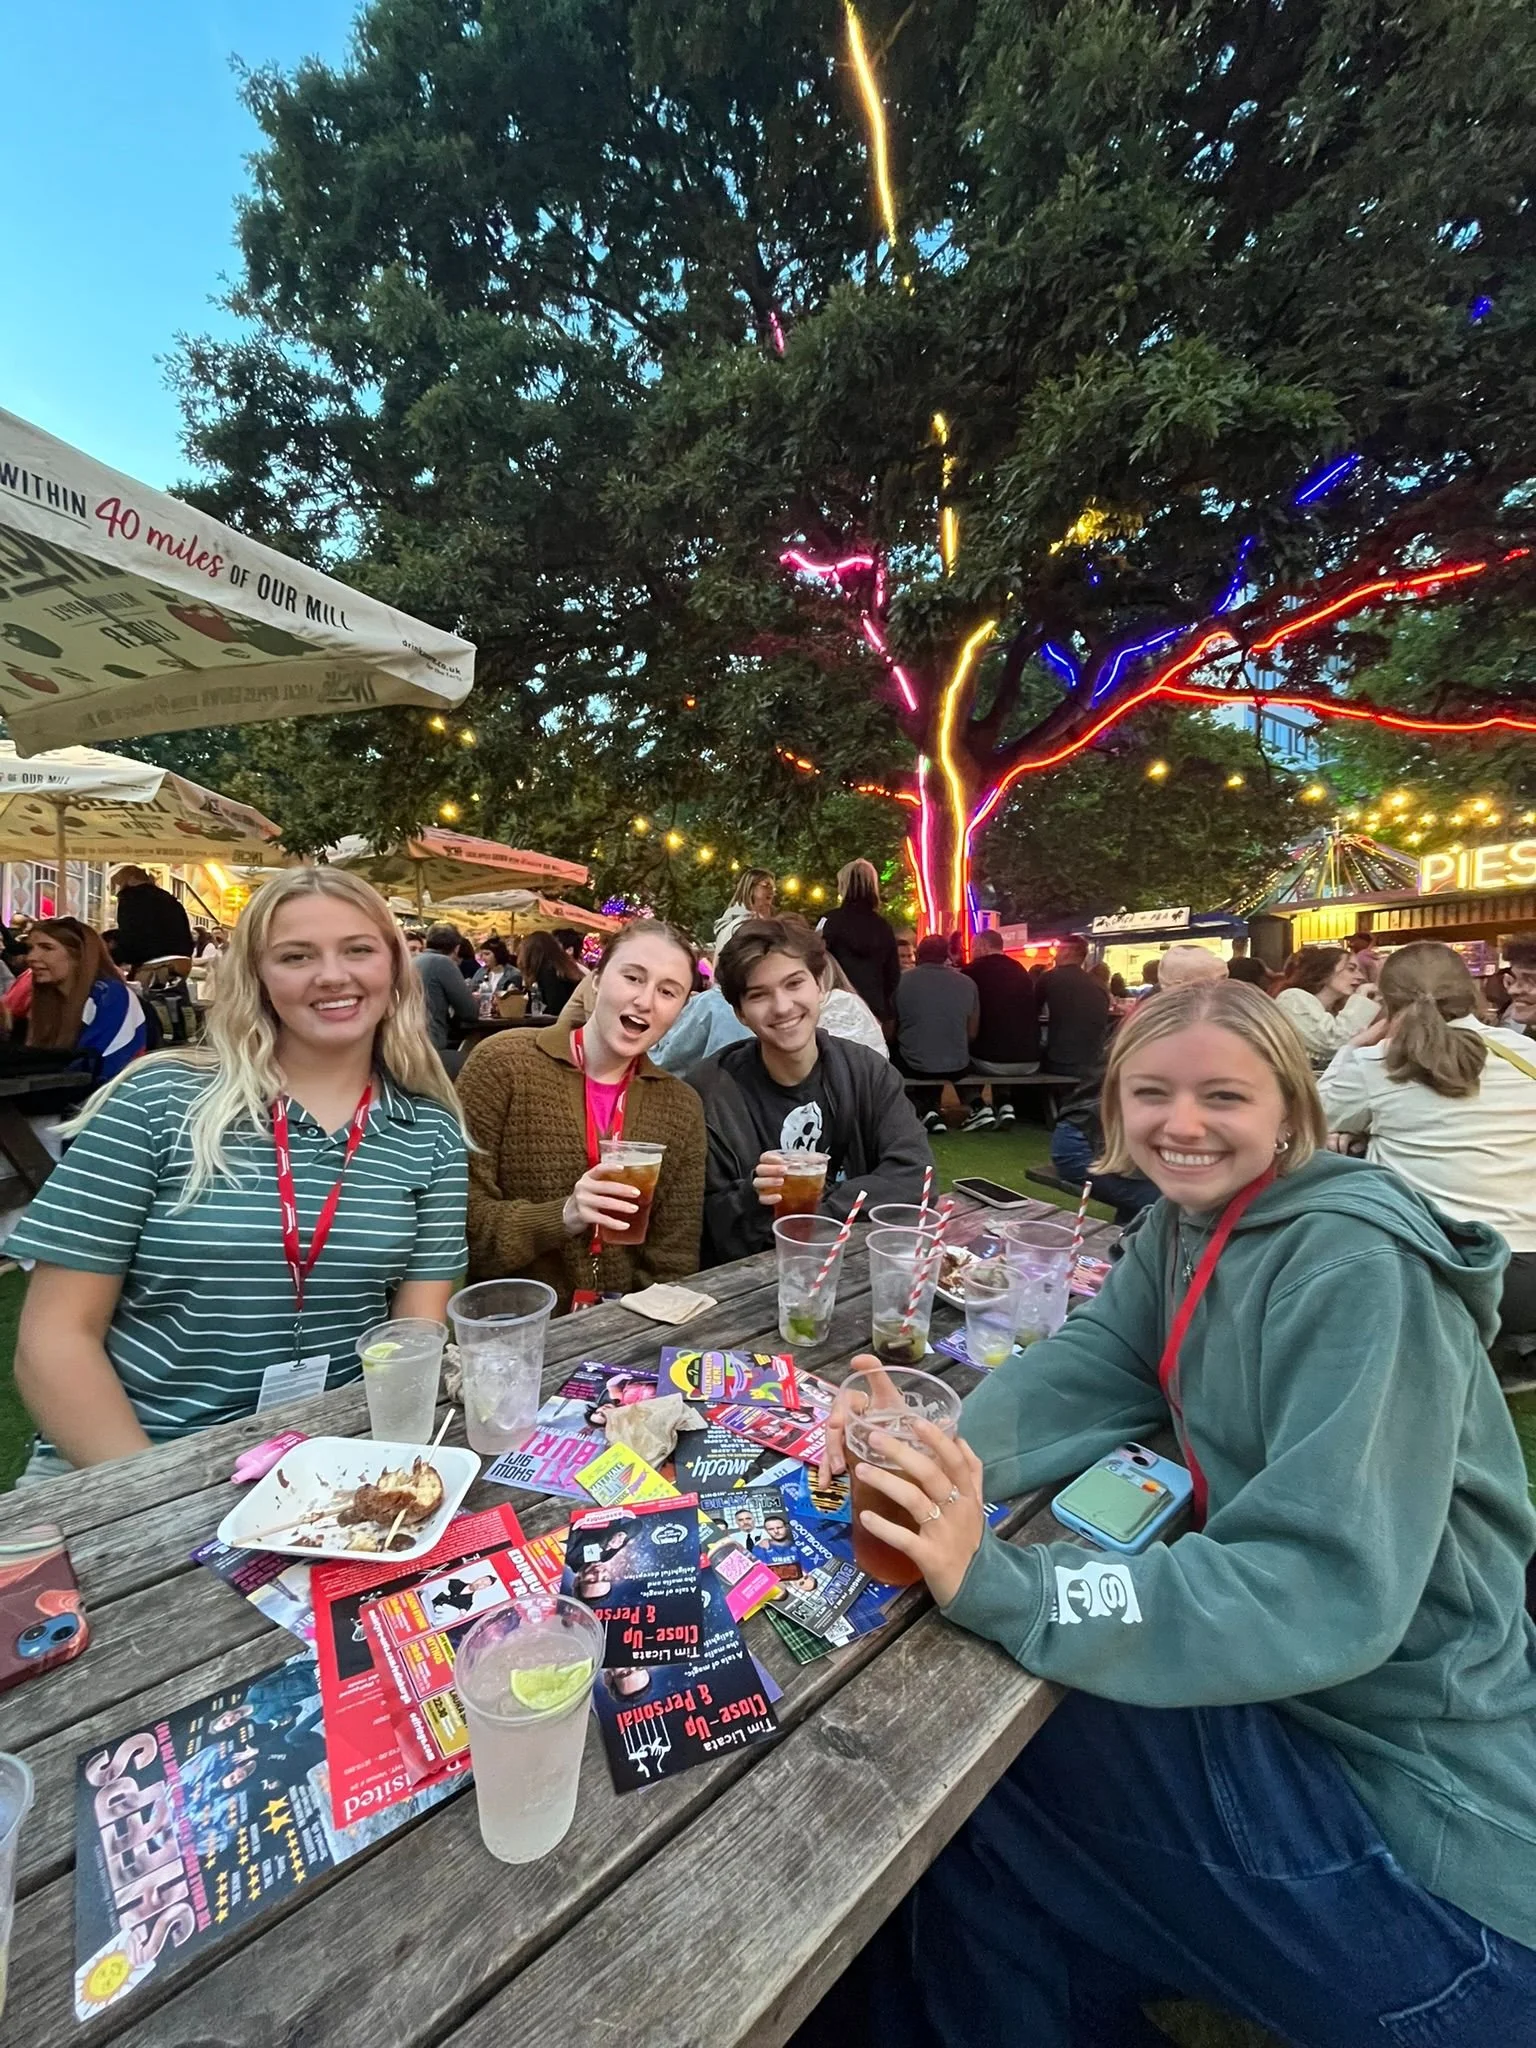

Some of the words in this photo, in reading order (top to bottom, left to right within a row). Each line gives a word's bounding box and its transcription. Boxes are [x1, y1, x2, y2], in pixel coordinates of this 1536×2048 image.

[0, 462, 87, 518] WITHIN
[95, 497, 140, 540] 40
[147, 526, 224, 577] miles
[230, 564, 250, 588] OF
[257, 573, 297, 613] OUR
[305, 594, 354, 632] MILL
[22, 773, 43, 785] OUR
[1422, 838, 1536, 893] PIES
[504, 1451, 534, 1466] girl
[491, 1463, 535, 1482] SHOW
[701, 1494, 748, 1510] BILLY
[661, 1566, 696, 1576] delightful
[647, 1580, 662, 1589] and
[664, 1577, 685, 1586] mafia
[822, 1562, 857, 1606] BILLY
[666, 1589, 673, 1597] of
[646, 1605, 656, 1623] &
[623, 1625, 699, 1649] Close-Up
[726, 1640, 739, 1650] the
[632, 1649, 670, 1661] Licata
[675, 1646, 700, 1658] Tim
[721, 1654, 737, 1666] tale
[737, 1650, 743, 1659] A
[711, 1660, 720, 1670] of
[697, 1683, 713, 1706] &
[615, 1689, 697, 1735] Personal
[684, 1693, 768, 1740] Close-Up
[747, 1717, 777, 1734] Tim
[409, 1712, 435, 1762] edfringe.com
[702, 1729, 747, 1752] Licata
[86, 1732, 195, 1966] SHEEPS
